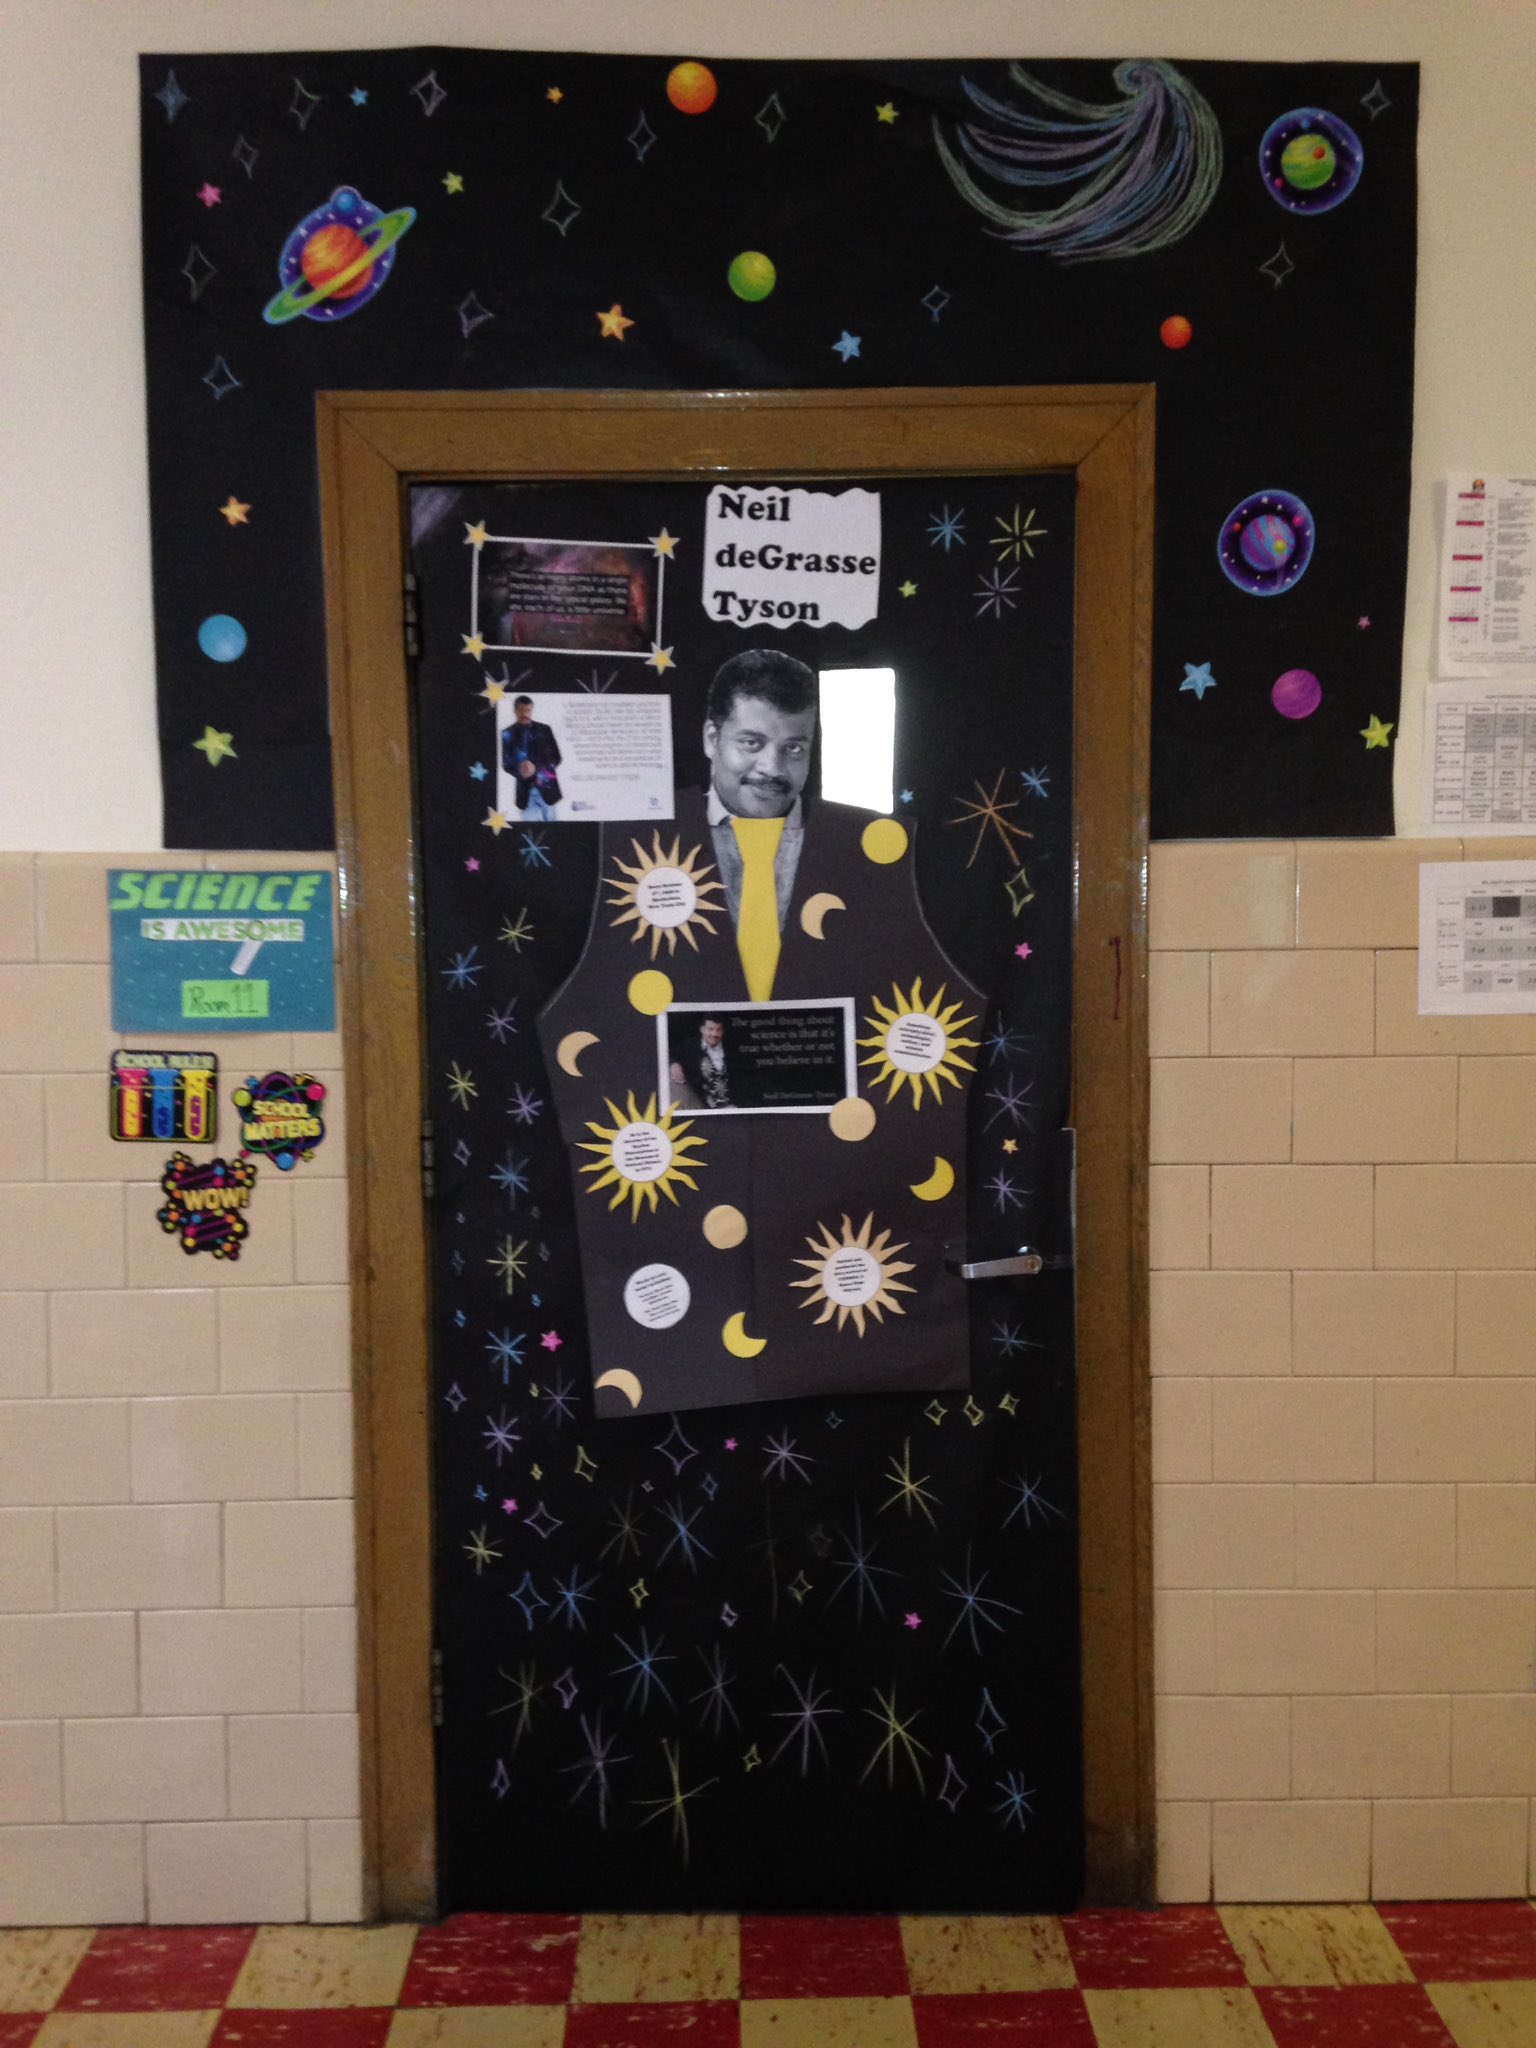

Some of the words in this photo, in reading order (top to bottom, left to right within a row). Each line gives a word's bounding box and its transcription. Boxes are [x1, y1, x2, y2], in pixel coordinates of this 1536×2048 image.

[718, 493, 790, 521] Neil
[716, 543, 876, 574] deGrasse
[713, 590, 819, 622] Tyson
[111, 873, 321, 911] SCIENCE
[142, 921, 165, 939] IS
[174, 920, 302, 941] AWESOME
[188, 986, 230, 1014] Room
[232, 984, 259, 1013] 11
[252, 1100, 312, 1118] SCHOOL
[244, 1118, 321, 1141] MATTERS
[183, 1187, 249, 1211] WOW!
